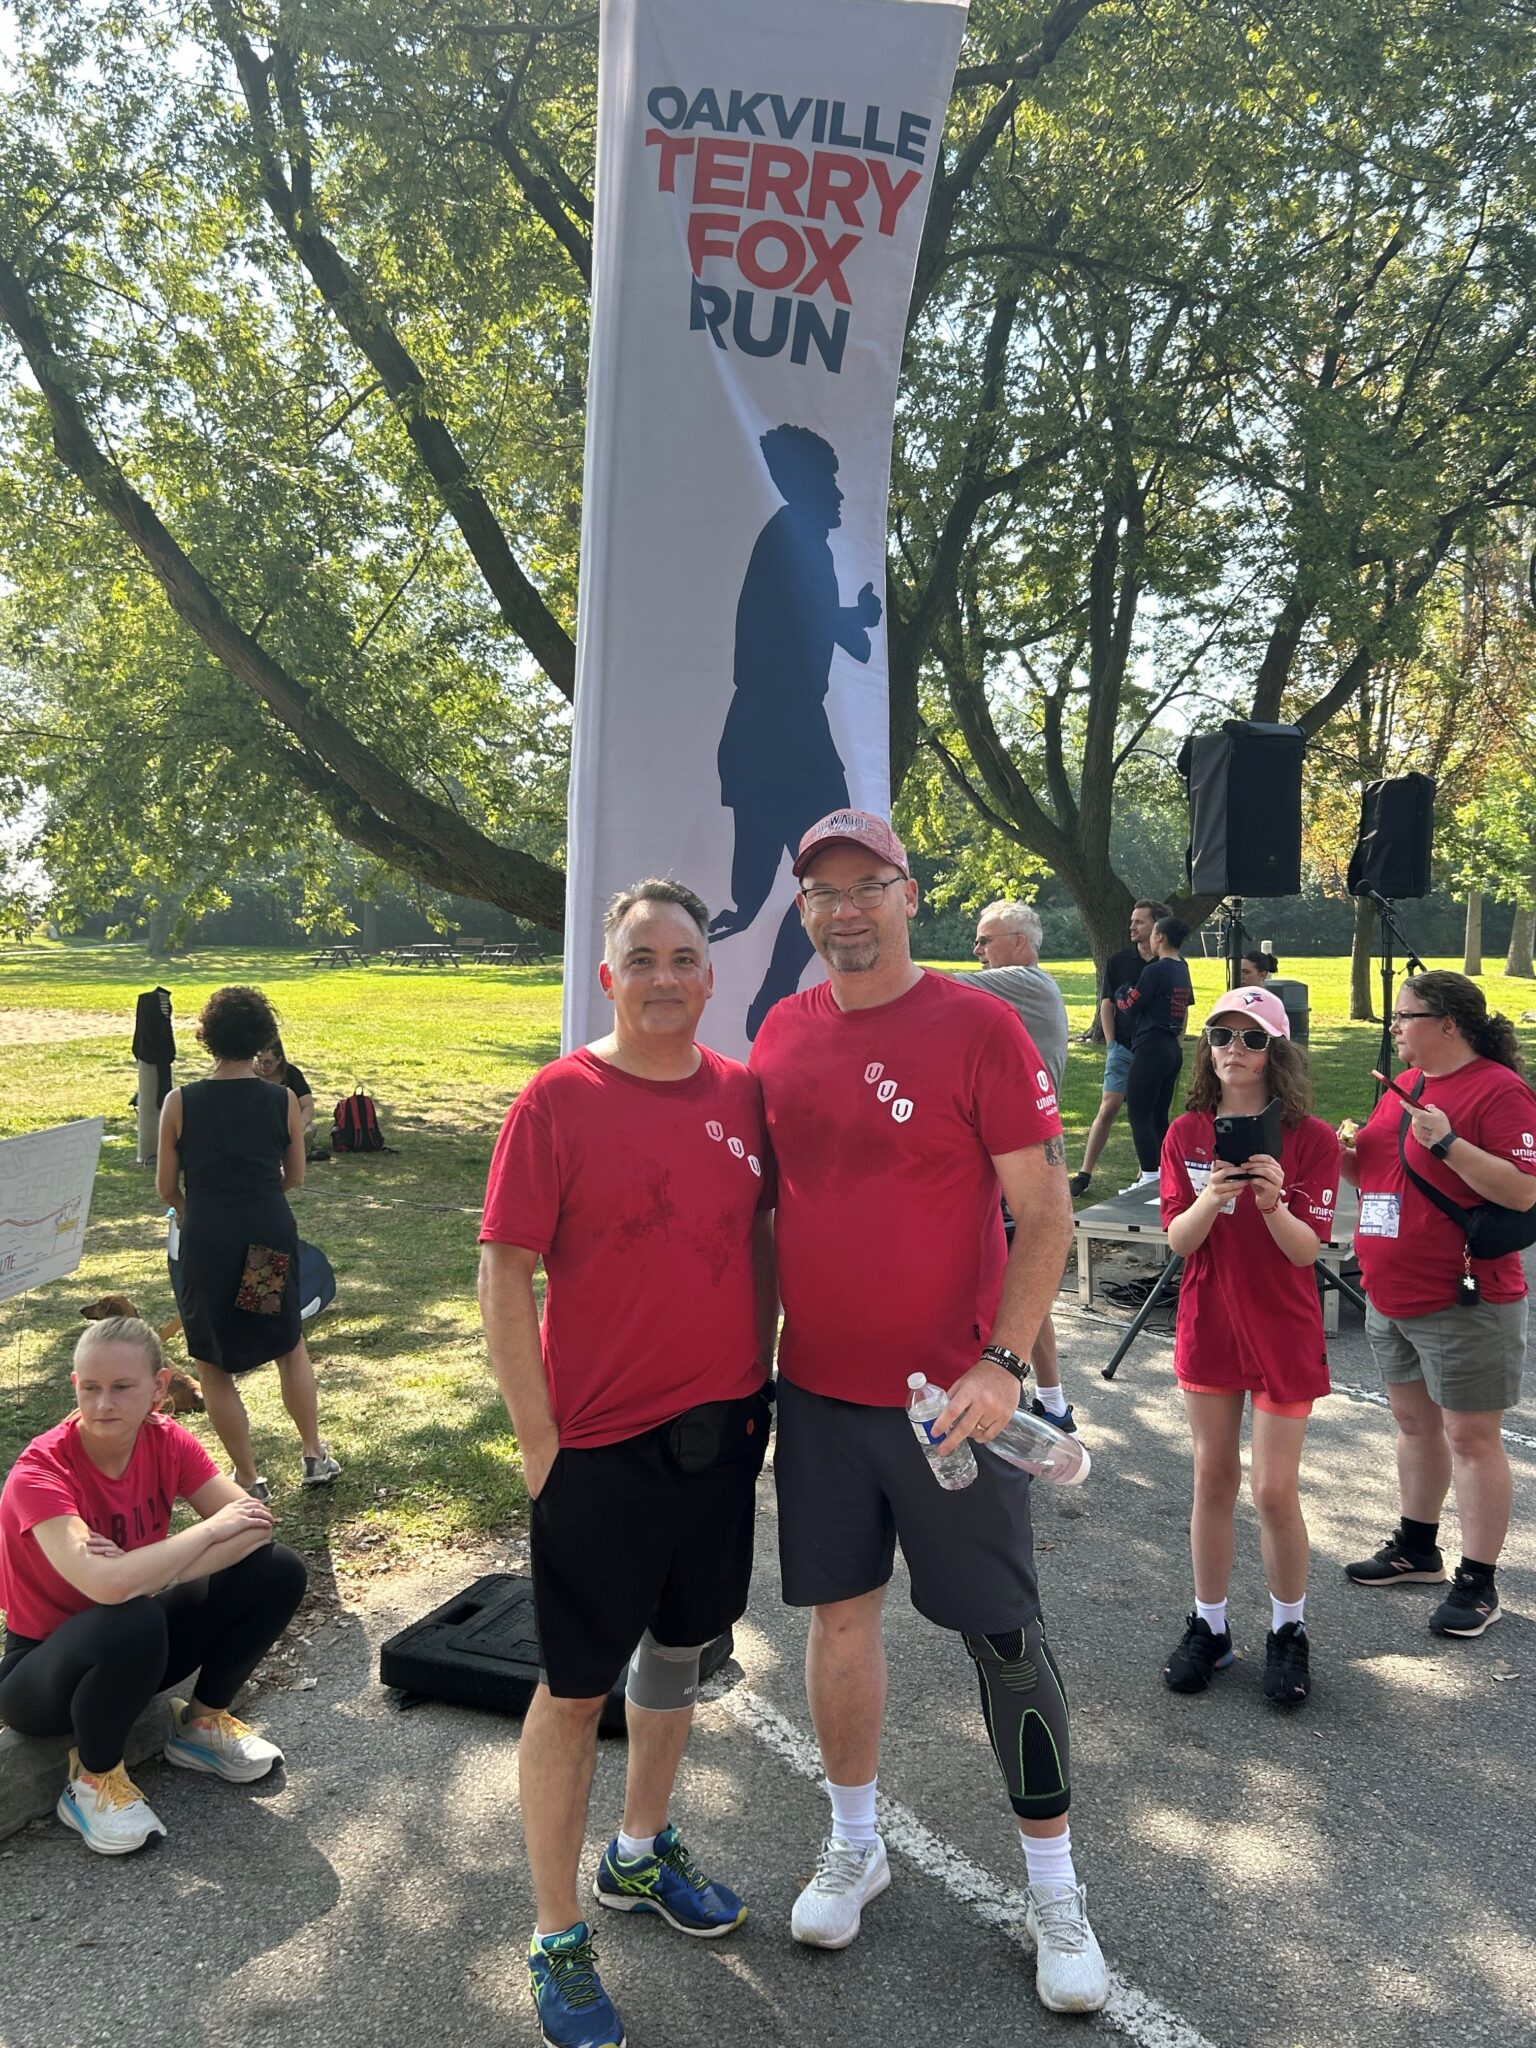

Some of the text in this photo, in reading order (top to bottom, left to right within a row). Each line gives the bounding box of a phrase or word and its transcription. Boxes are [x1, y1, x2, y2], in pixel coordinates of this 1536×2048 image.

[647, 86, 932, 165] OAKVILLE
[645, 127, 923, 237] TERRY
[688, 212, 863, 306] FOX
[690, 273, 850, 374] RUN
